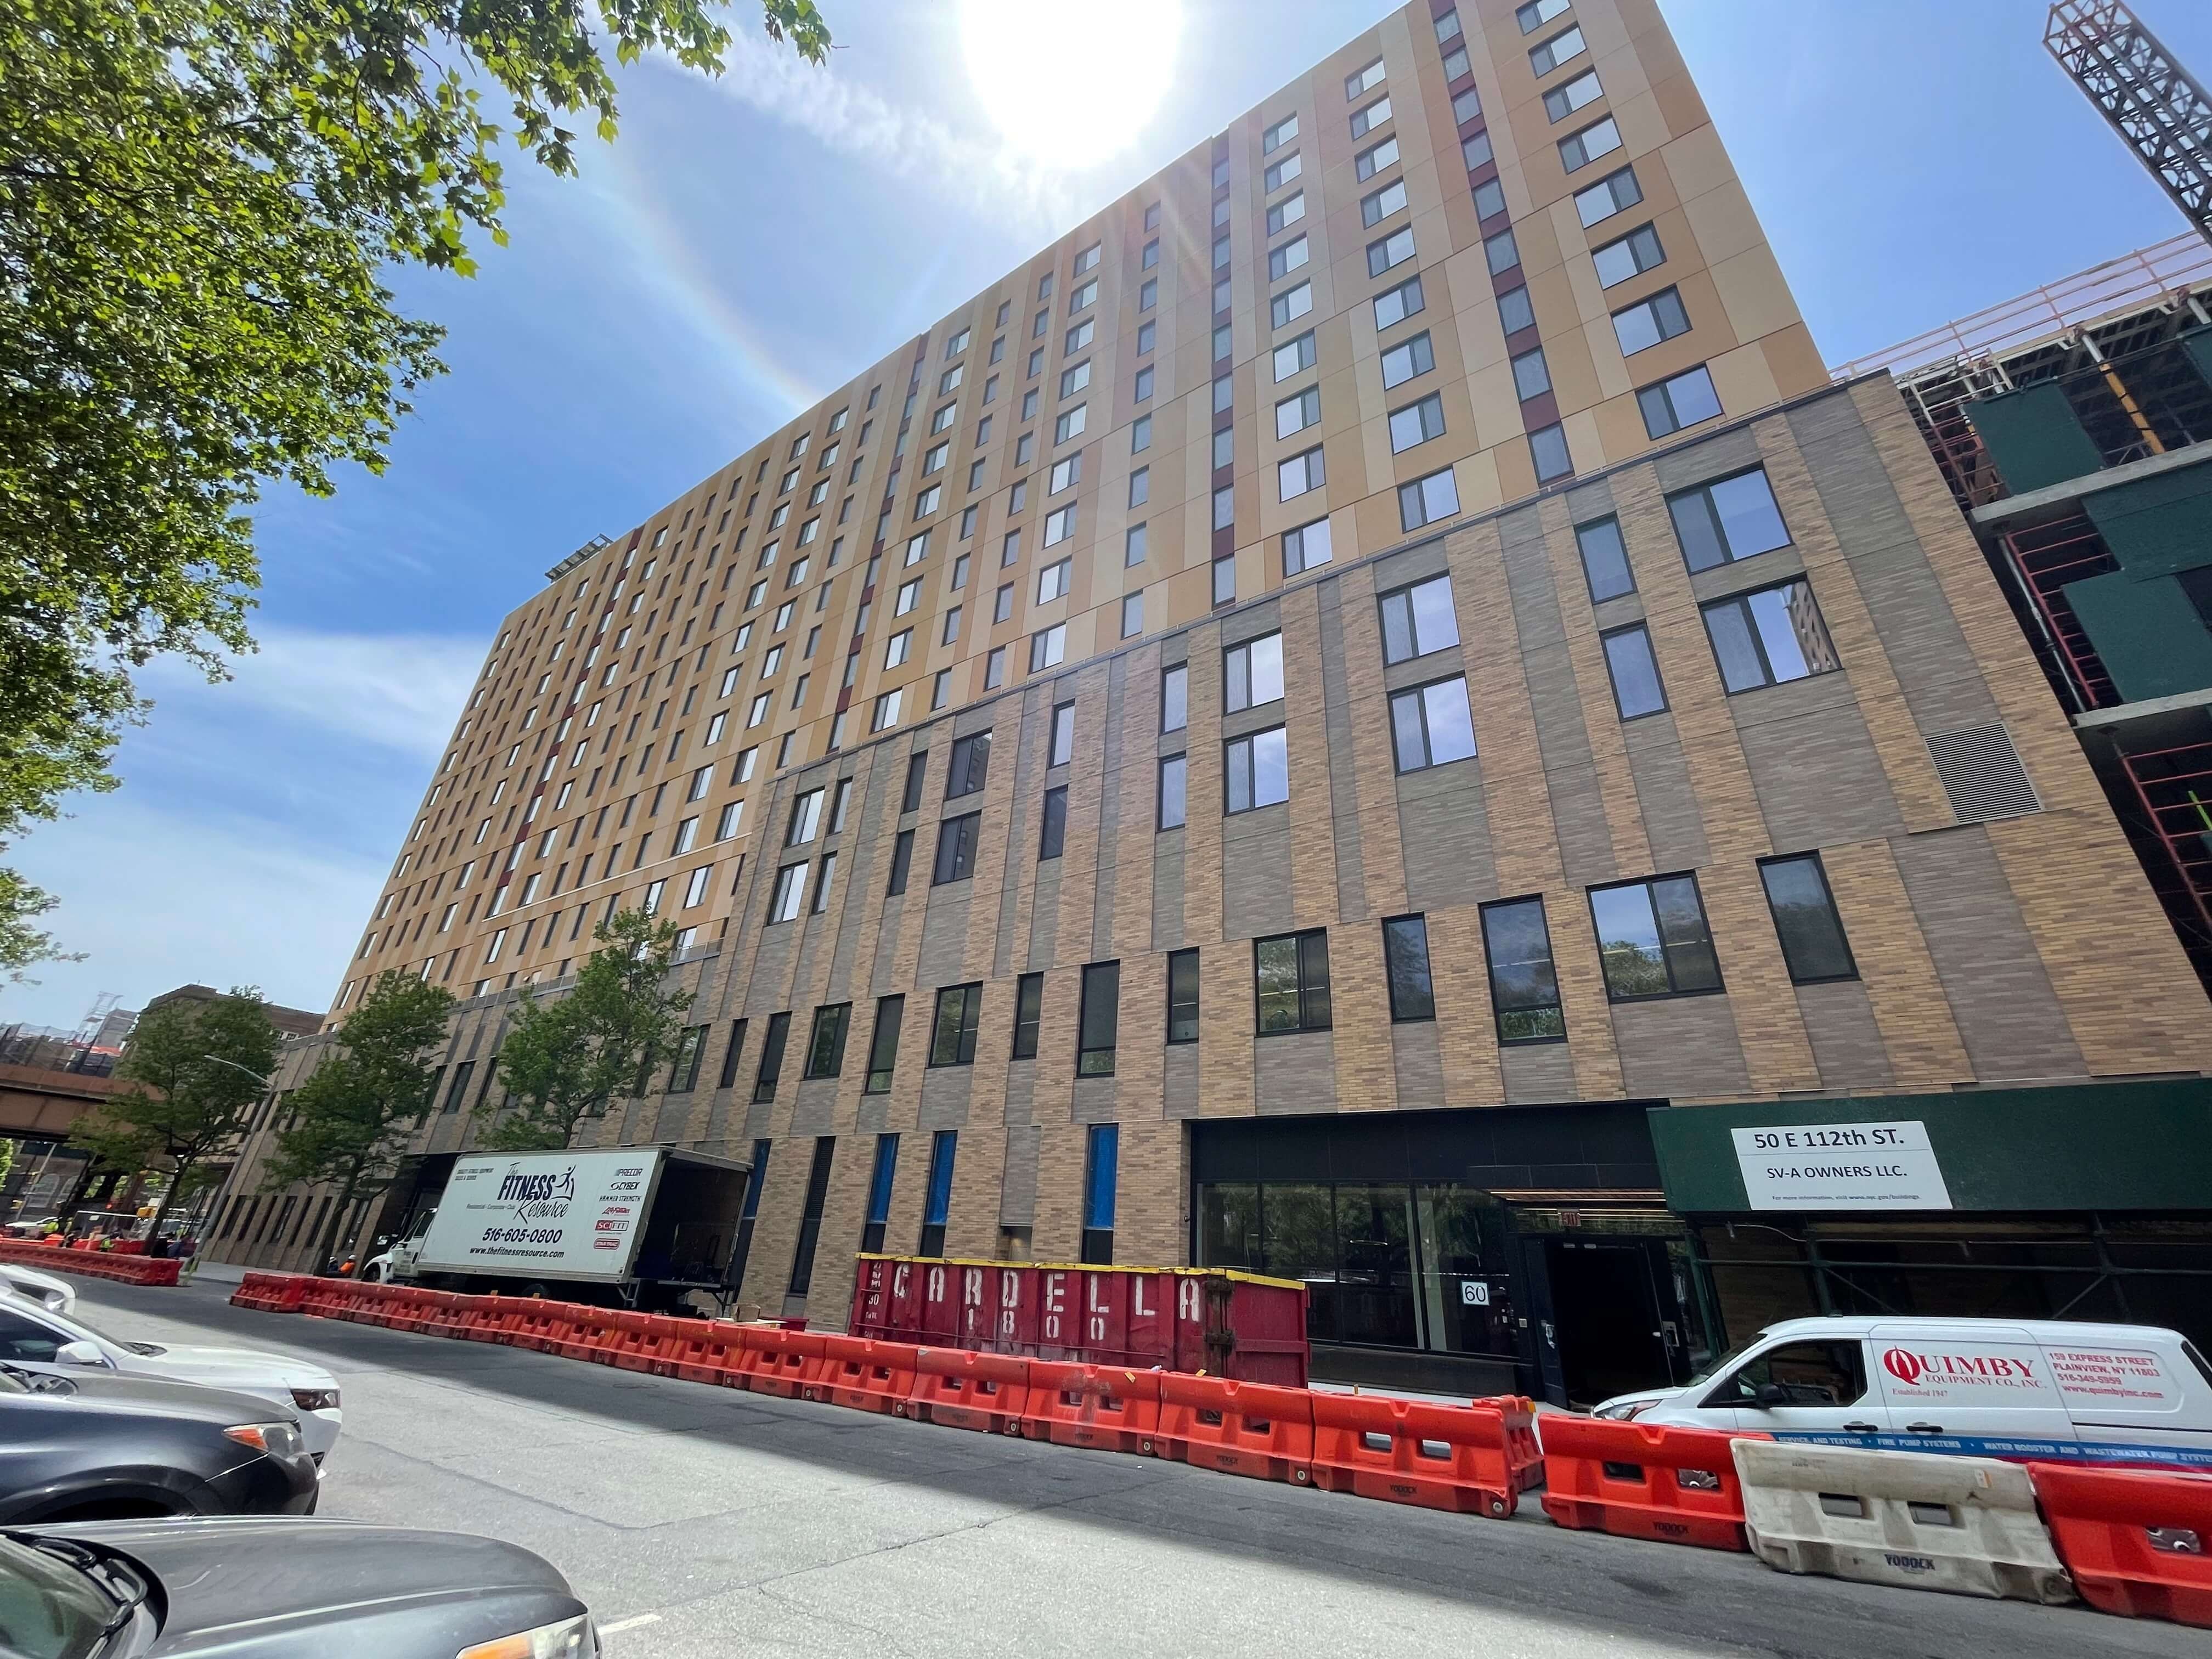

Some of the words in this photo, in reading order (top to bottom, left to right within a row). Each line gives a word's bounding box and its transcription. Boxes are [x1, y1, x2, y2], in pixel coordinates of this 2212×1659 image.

[1754, 1133, 1780, 1148] 50
[1785, 1132, 1798, 1147] E
[1803, 1130, 1866, 1147] 112th
[1872, 1129, 1904, 1145] ST.
[507, 1162, 521, 1175] The
[1767, 1167, 1801, 1178] SV-A
[1804, 1166, 1872, 1178] OWNERS
[1875, 1165, 1907, 1176] LLC.
[497, 1175, 556, 1200] FITNESS
[514, 1193, 568, 1224] Resource
[482, 1228, 562, 1243] 516-605-0800
[470, 1246, 564, 1258] www.thefitnessresource.com
[894, 1263, 1200, 1322] CARDELLA
[1465, 1285, 1486, 1302] 60
[1883, 1346, 2034, 1386] QUIMBY
[2068, 1353, 2112, 1363] EXPRESS
[2115, 1356, 2154, 1365] STREET
[2053, 1362, 2111, 1374] PLAINVIEW,
[2112, 1366, 2126, 1375] NY
[2129, 1368, 2160, 1377] 11803
[1925, 1374, 1993, 1386] EQUIPMENT
[2021, 1380, 2048, 1389] INC.
[1892, 1388, 1930, 1396] Established
[1899, 1438, 1921, 1447] PUMP
[1922, 1440, 1961, 1448] SYSTEMS
[1983, 1442, 2012, 1451] WATER
[2014, 1443, 2056, 1454] BOOSTER
[2060, 1446, 2078, 1455] AND
[2084, 1447, 2148, 1458] WASTEWATER
[2149, 1451, 2178, 1460] PUMP
[1884, 1554, 1936, 1571] YODOCK
